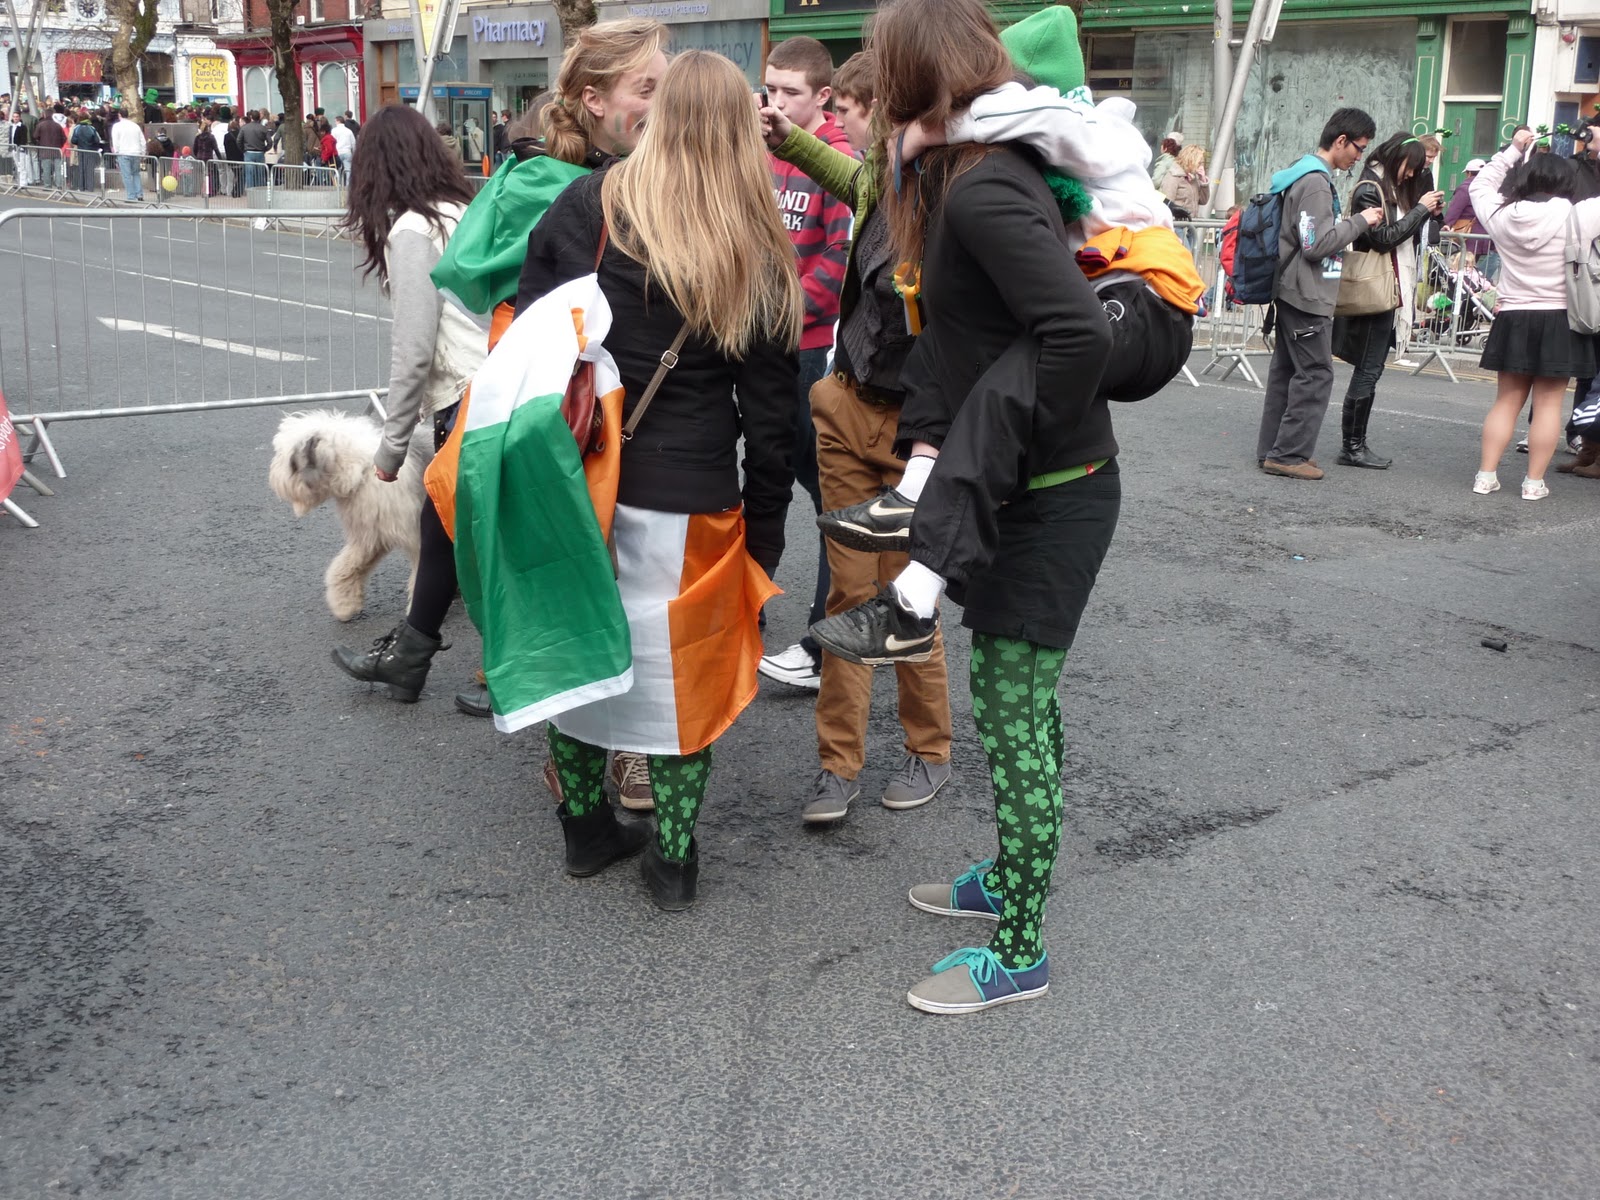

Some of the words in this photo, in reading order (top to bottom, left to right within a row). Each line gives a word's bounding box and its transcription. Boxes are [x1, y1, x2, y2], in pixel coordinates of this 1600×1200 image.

[675, 3, 709, 15] Pharmacy
[472, 16, 545, 46] Pharmacy
[212, 69, 224, 78] City
